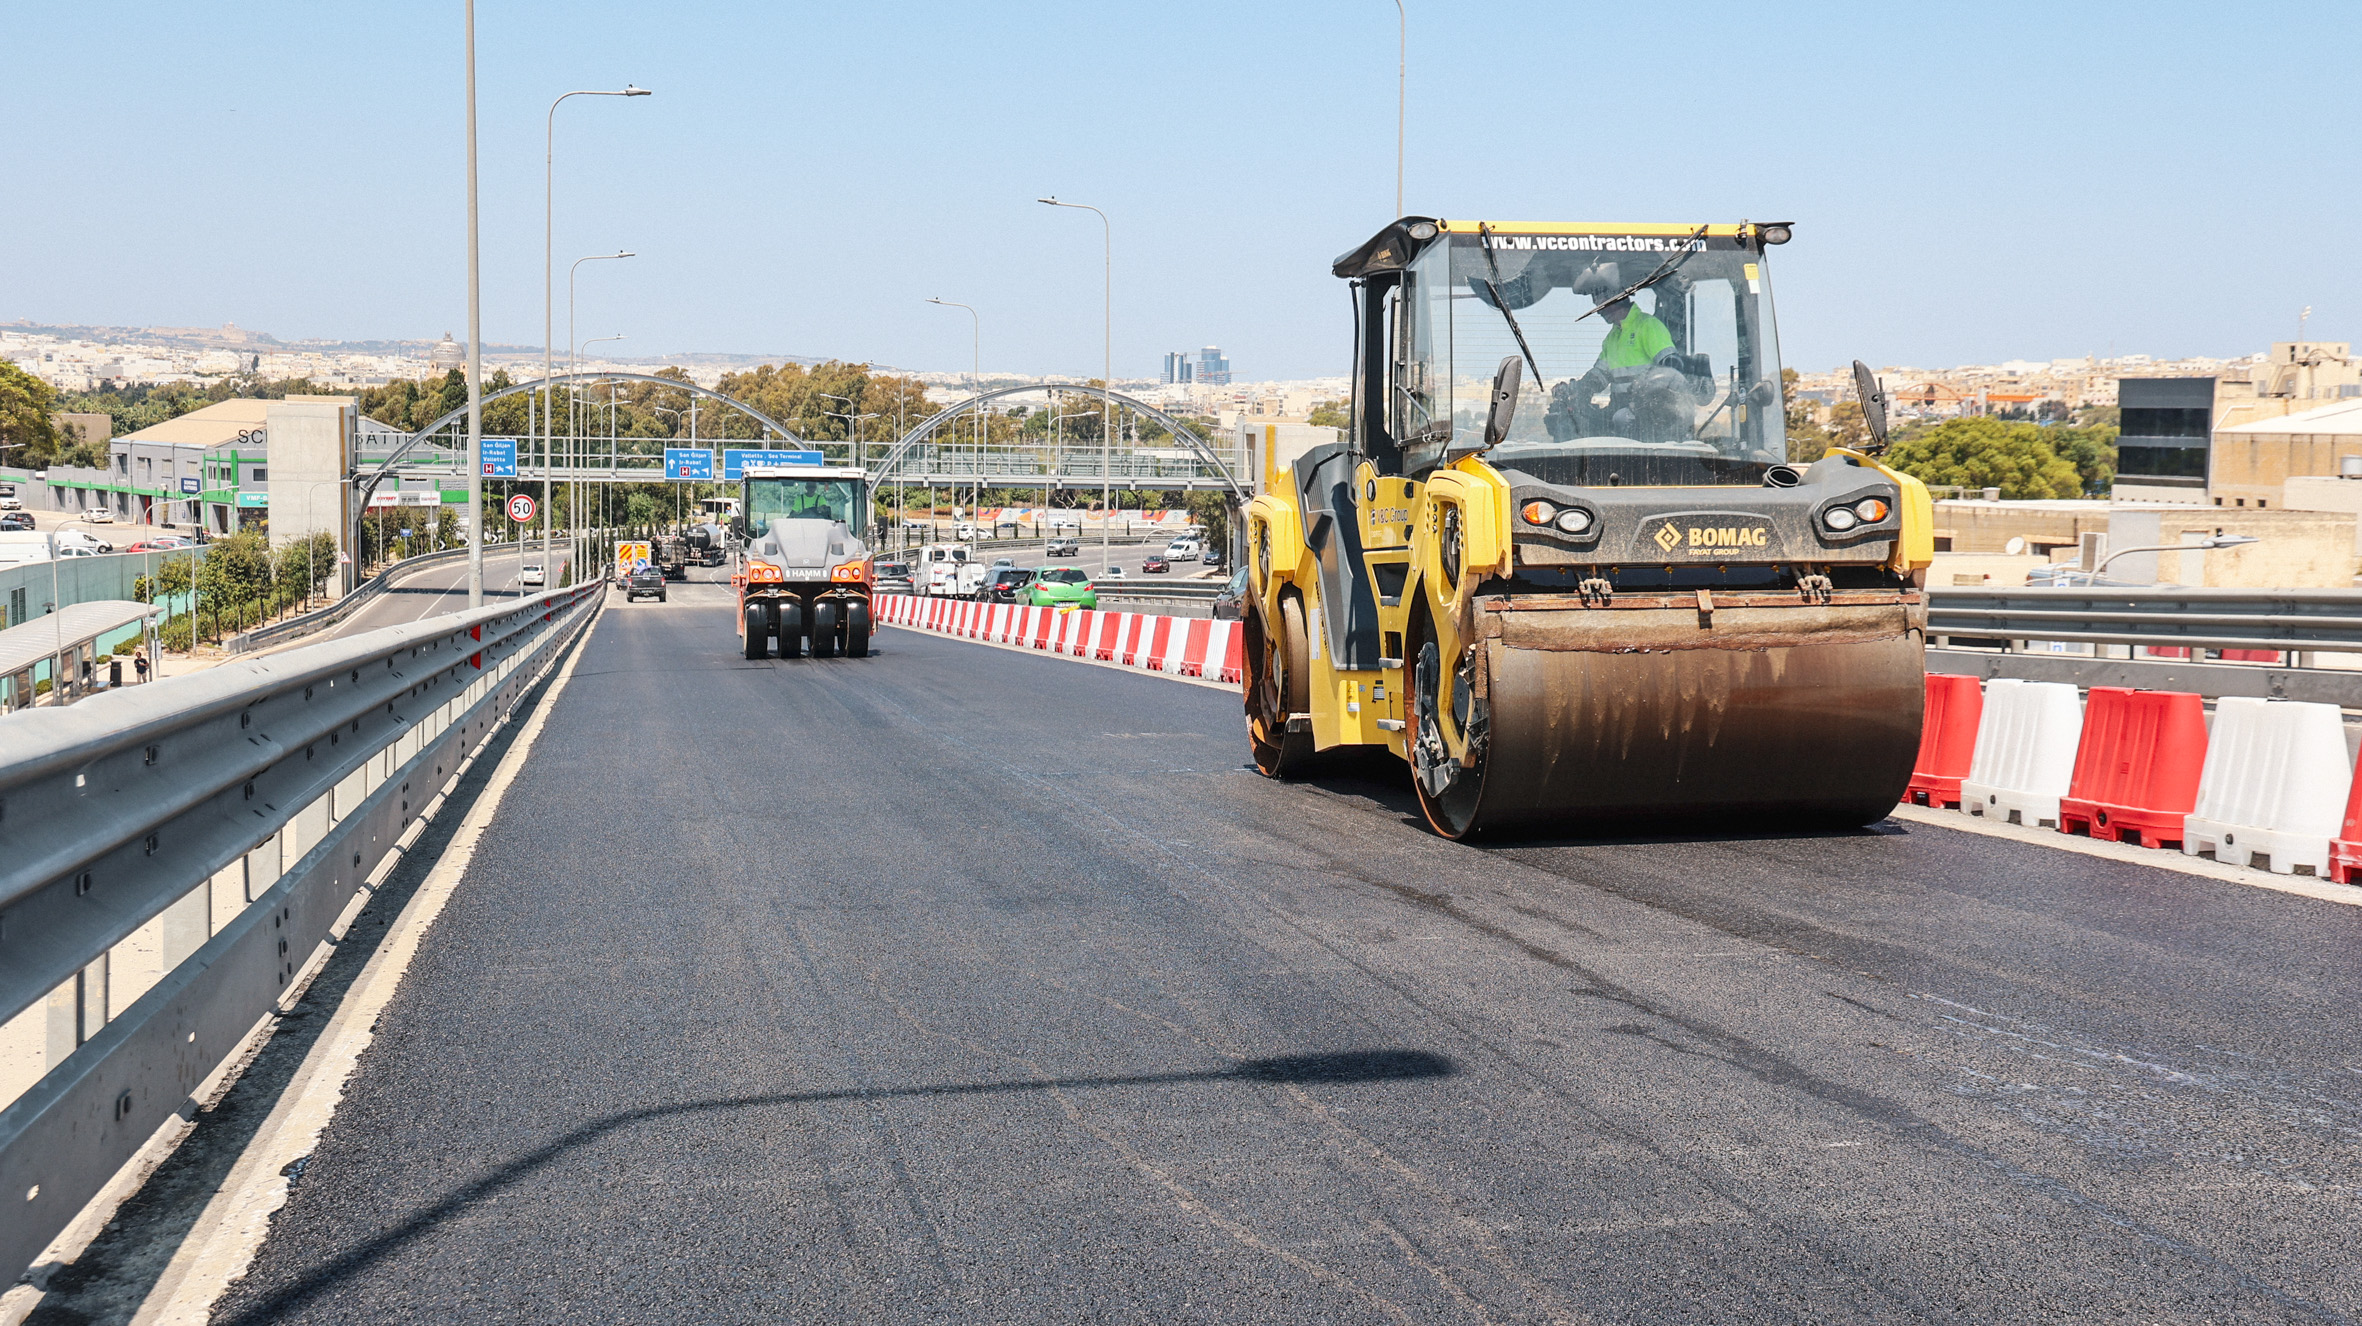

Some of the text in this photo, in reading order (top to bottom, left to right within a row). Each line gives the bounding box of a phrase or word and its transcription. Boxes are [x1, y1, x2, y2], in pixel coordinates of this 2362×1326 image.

[237, 429, 268, 444] SC
[513, 502, 531, 515] 50
[1390, 507, 1408, 525] Group
[1689, 527, 1767, 546] BOMAG
[1688, 548, 1740, 556] FAYAT GROUP
[792, 569, 821, 577] HAMM
